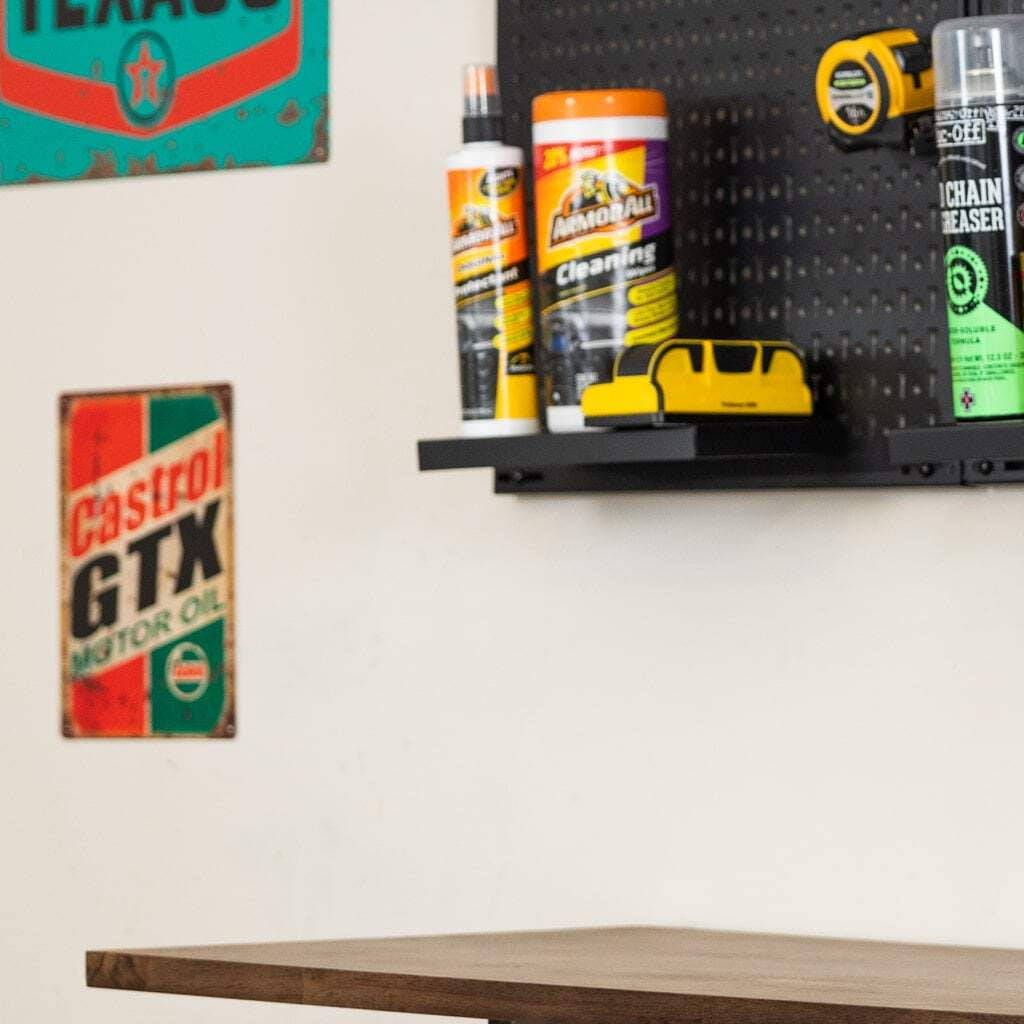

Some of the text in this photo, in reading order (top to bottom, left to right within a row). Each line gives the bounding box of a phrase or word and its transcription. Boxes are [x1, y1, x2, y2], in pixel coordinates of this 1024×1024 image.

[945, 177, 1002, 207] CHAIN
[555, 242, 657, 286] Cleaning
[71, 429, 225, 558] Castrol
[71, 499, 223, 641] GTX
[71, 588, 225, 678] MOTOR OIL
